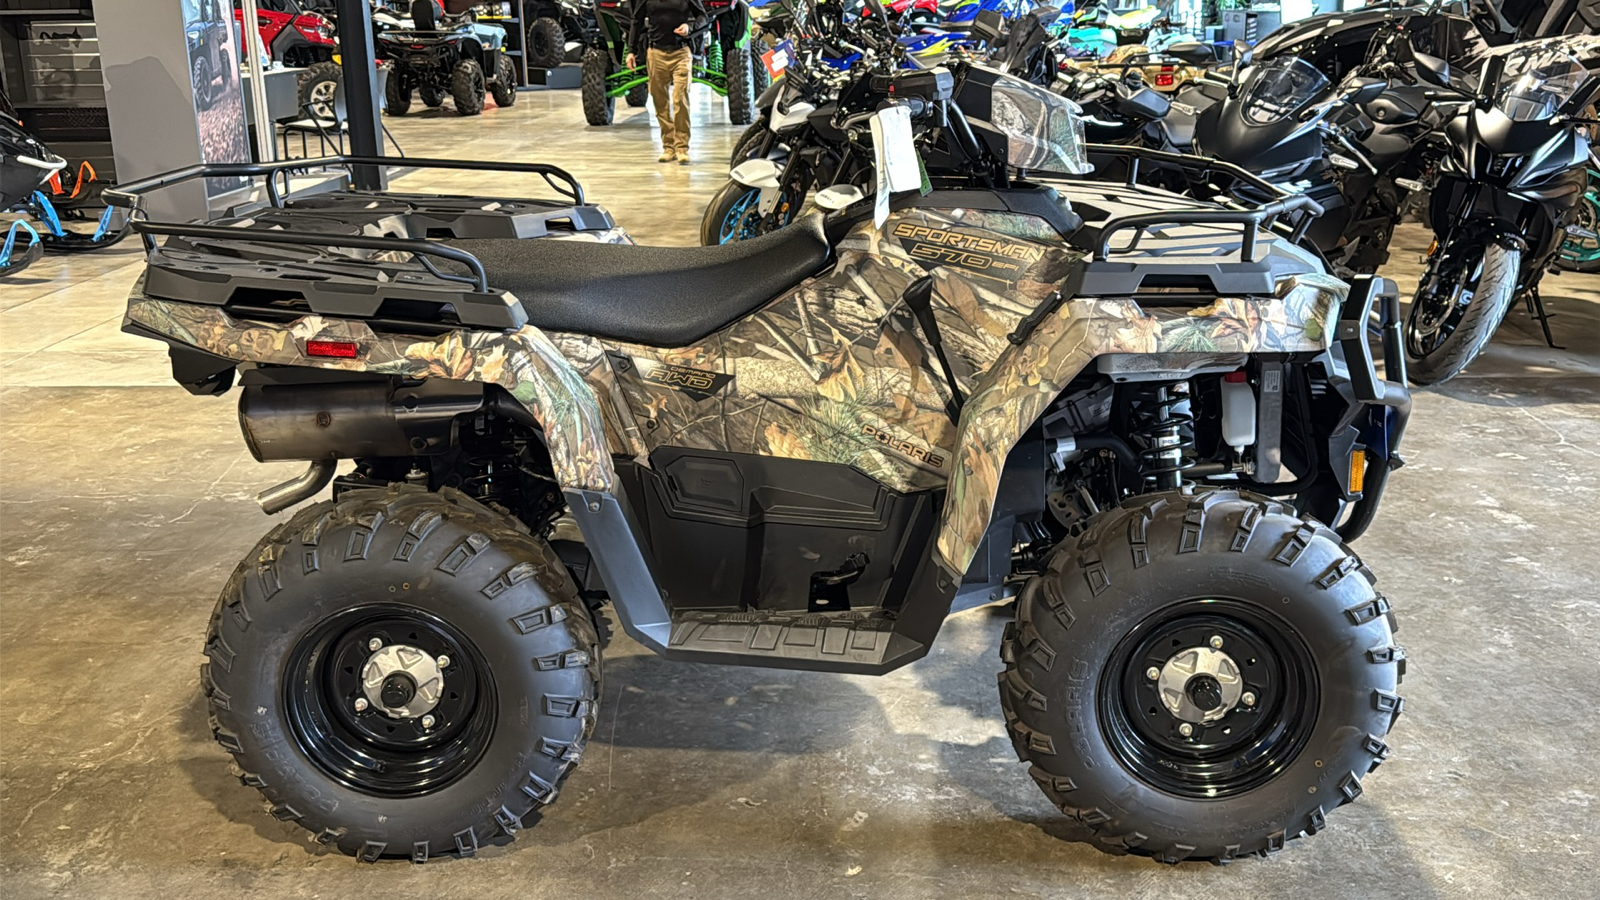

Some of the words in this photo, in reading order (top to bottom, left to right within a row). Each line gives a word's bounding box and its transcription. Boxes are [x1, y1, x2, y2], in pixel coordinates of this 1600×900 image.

[893, 223, 1047, 262] SPORTSMAN
[910, 243, 993, 269] 570
[992, 261, 1019, 272] EFI
[644, 368, 713, 389] AWD
[671, 367, 716, 378] DEMAND
[861, 424, 945, 467] POLARIS
